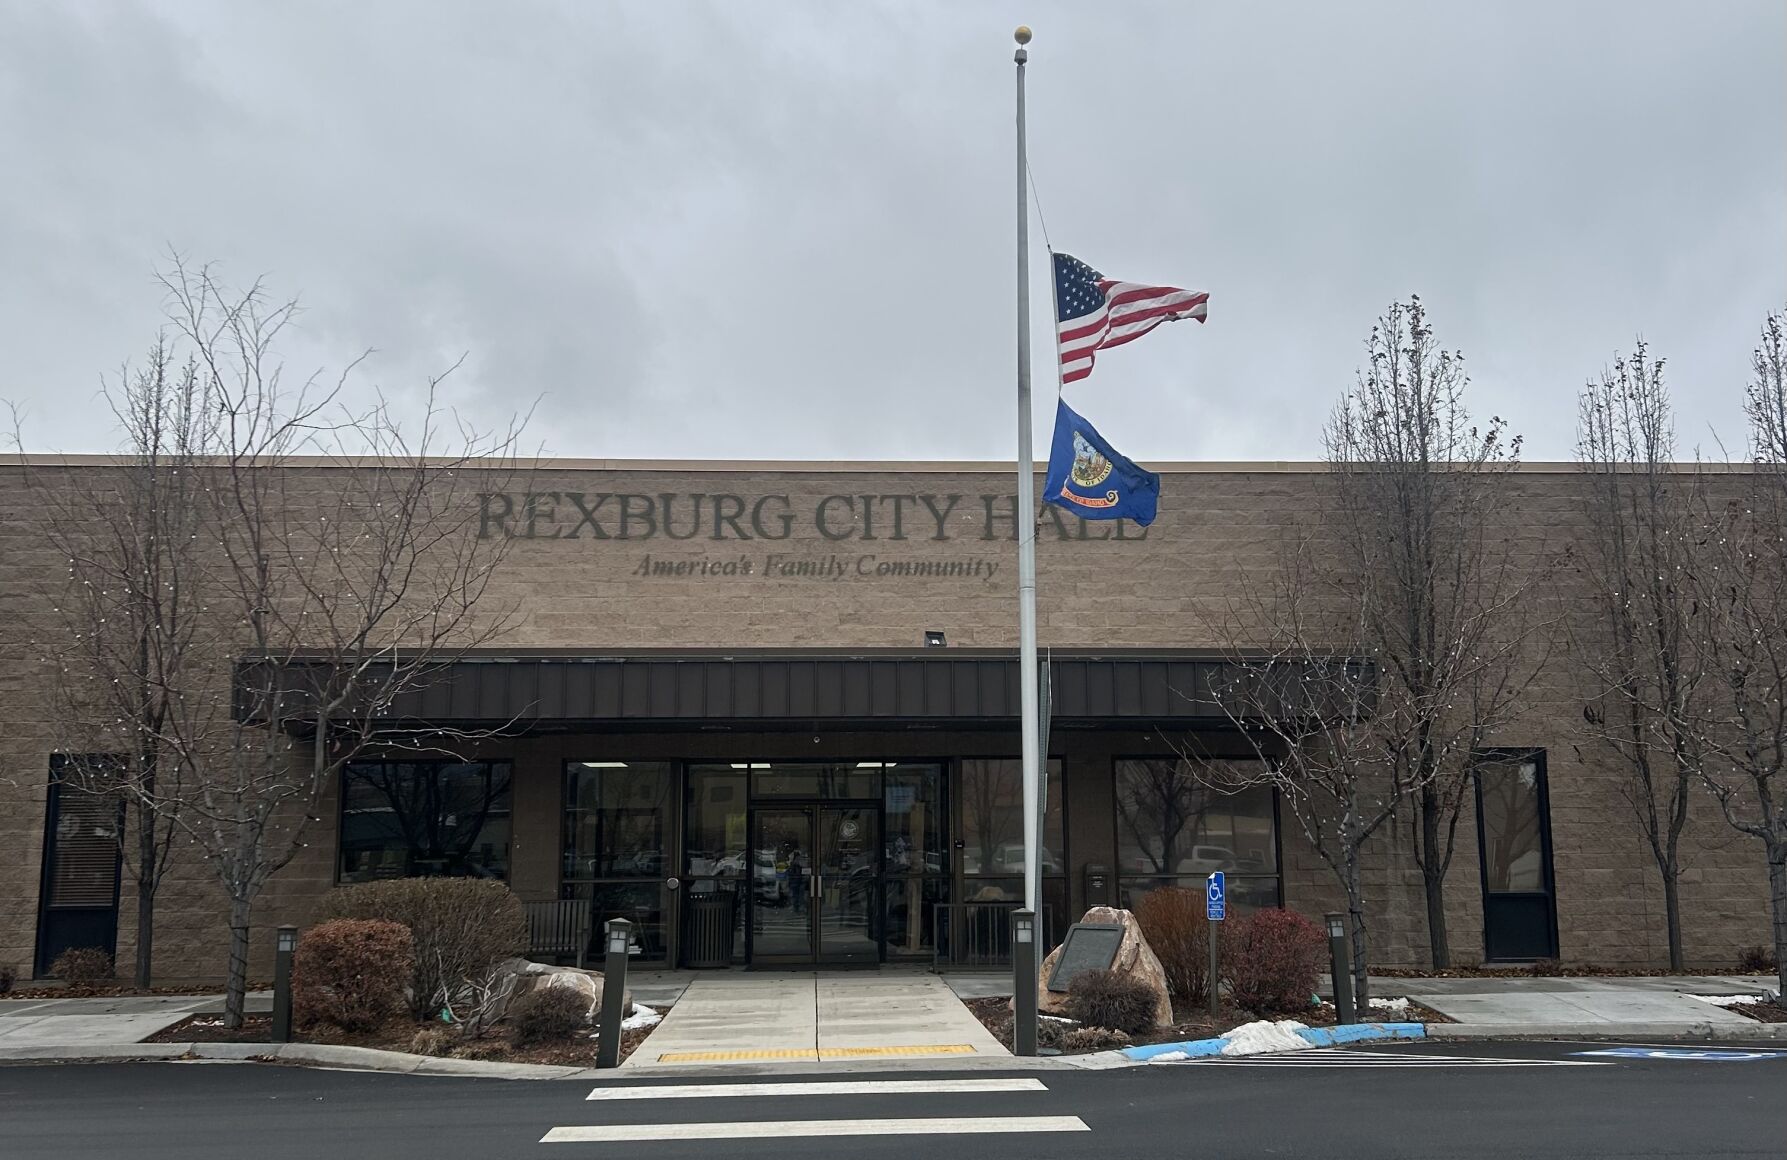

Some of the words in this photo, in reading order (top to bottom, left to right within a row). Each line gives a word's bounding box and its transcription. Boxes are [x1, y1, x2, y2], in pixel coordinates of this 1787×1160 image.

[475, 491, 797, 540] REXBURG
[815, 494, 963, 540] CITY
[632, 553, 753, 577] America's
[761, 553, 849, 581] Family
[856, 553, 999, 581] Community
